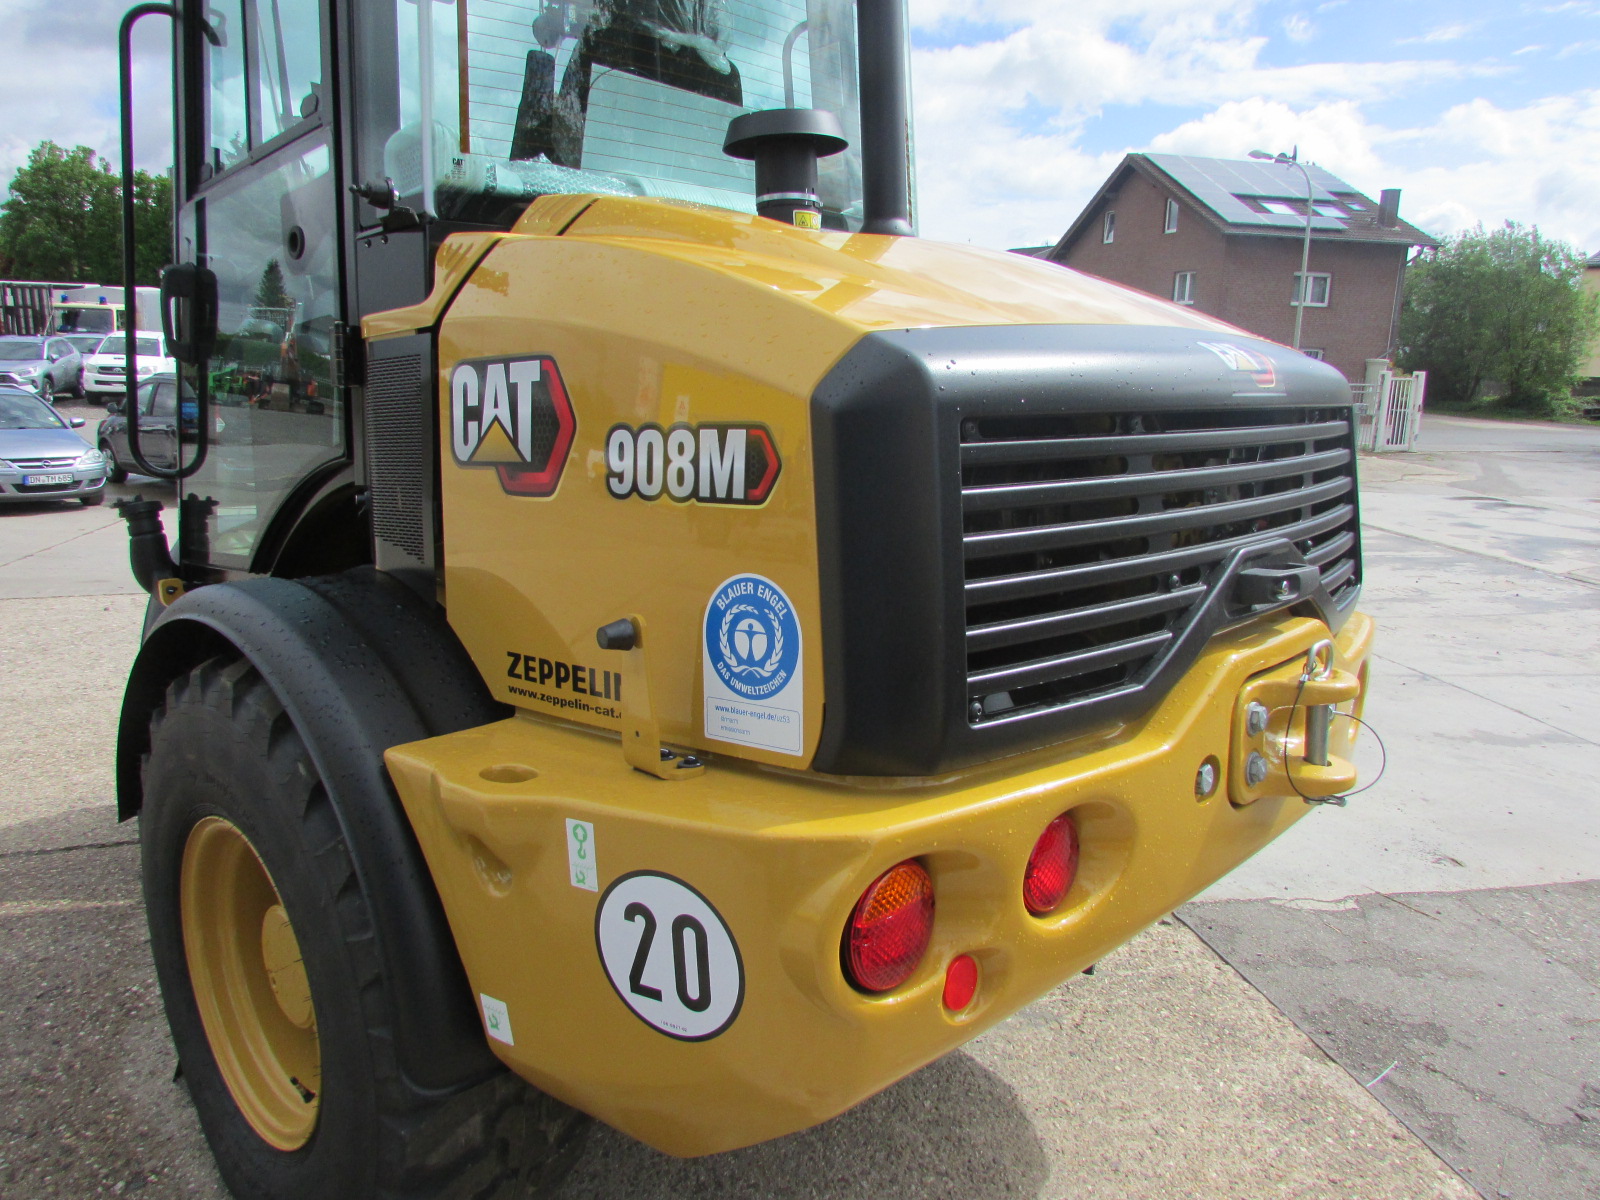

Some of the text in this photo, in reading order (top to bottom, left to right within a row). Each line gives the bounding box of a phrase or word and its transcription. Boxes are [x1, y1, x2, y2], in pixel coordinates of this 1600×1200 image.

[452, 360, 541, 463] CAT
[30, 476, 41, 484] DN
[608, 428, 747, 500] 908M
[716, 582, 788, 620] BLAUER ENGEL
[717, 661, 788, 695] DAS UMWELTZEICHEN
[508, 685, 621, 719] www.zeppelin-cat.
[624, 902, 712, 1012] 20
